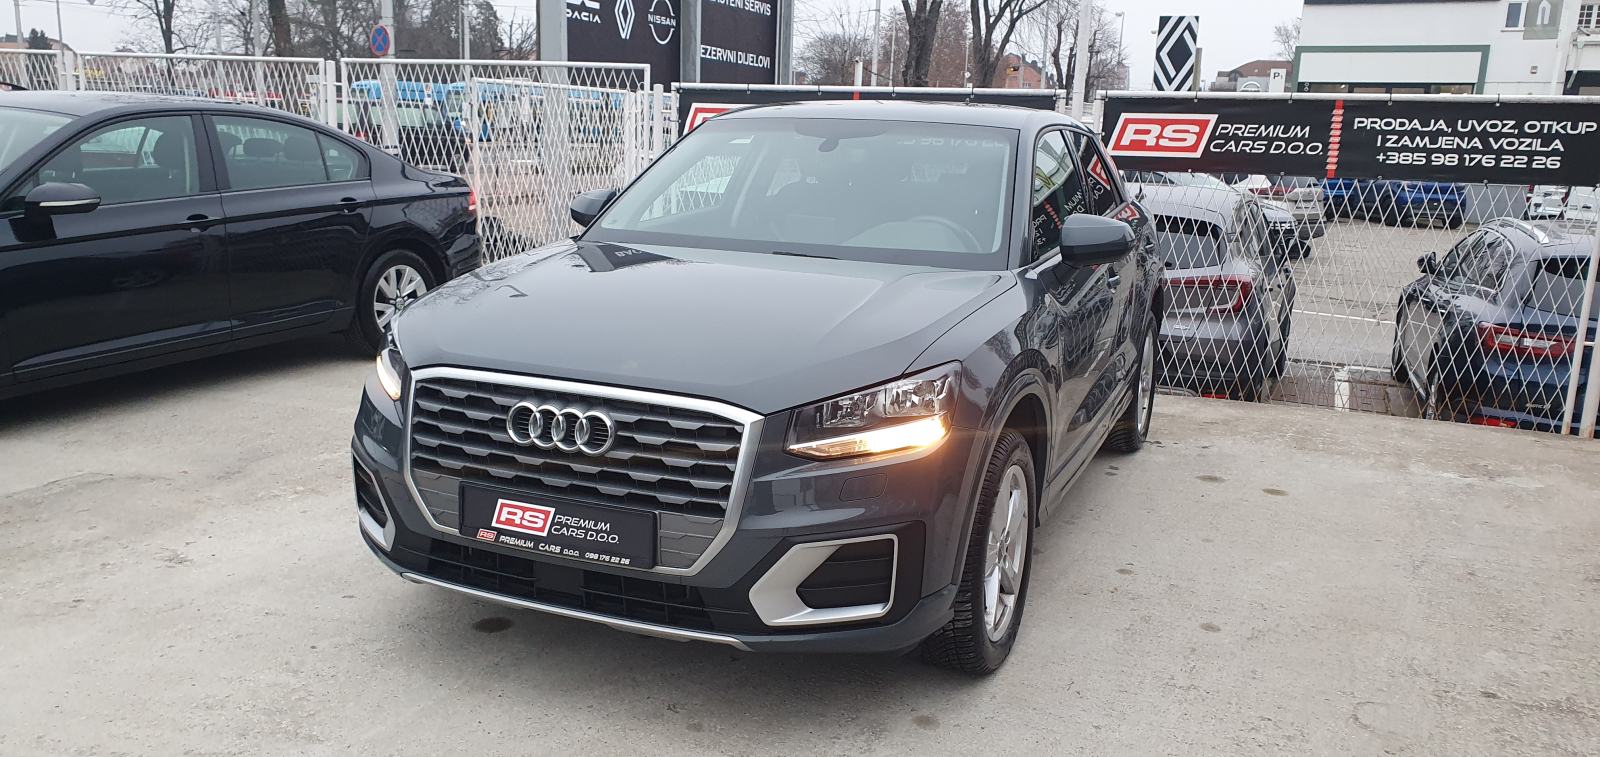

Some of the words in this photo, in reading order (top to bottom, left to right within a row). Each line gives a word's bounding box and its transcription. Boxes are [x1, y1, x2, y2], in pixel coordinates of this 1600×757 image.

[566, 8, 601, 24] DACIA
[744, 0, 771, 16] SERVIS
[647, 14, 676, 27] NISSAN
[700, 44, 737, 63] EZERVNI
[737, 51, 771, 69] DIJELOVI
[1215, 123, 1311, 139] PREMIUM
[1353, 117, 1453, 133] PRODAJA,
[1457, 119, 1518, 134] UVOZ,
[1524, 120, 1598, 135] OTKUP
[1119, 123, 1200, 148] RS
[1376, 134, 1382, 147] I
[1385, 135, 1483, 149] ZAMJENA
[1488, 137, 1565, 152] VOZILA
[1209, 139, 1267, 154] CARS
[1269, 141, 1324, 156] D.O.O.
[1375, 151, 1427, 165] +385
[1431, 153, 1459, 166] 98
[1463, 153, 1496, 167] 176
[1500, 155, 1527, 168] 22
[1531, 155, 1562, 169] 26
[499, 507, 546, 528] RS
[554, 514, 611, 532] PREMIUM
[551, 525, 585, 539] CARS
[586, 531, 620, 544] D.O.O.
[479, 531, 494, 539] RS
[499, 534, 534, 549] PREMIUM
[538, 543, 562, 554] CARS
[585, 552, 599, 560] 098
[599, 554, 610, 562] 176
[620, 557, 631, 565] 26
